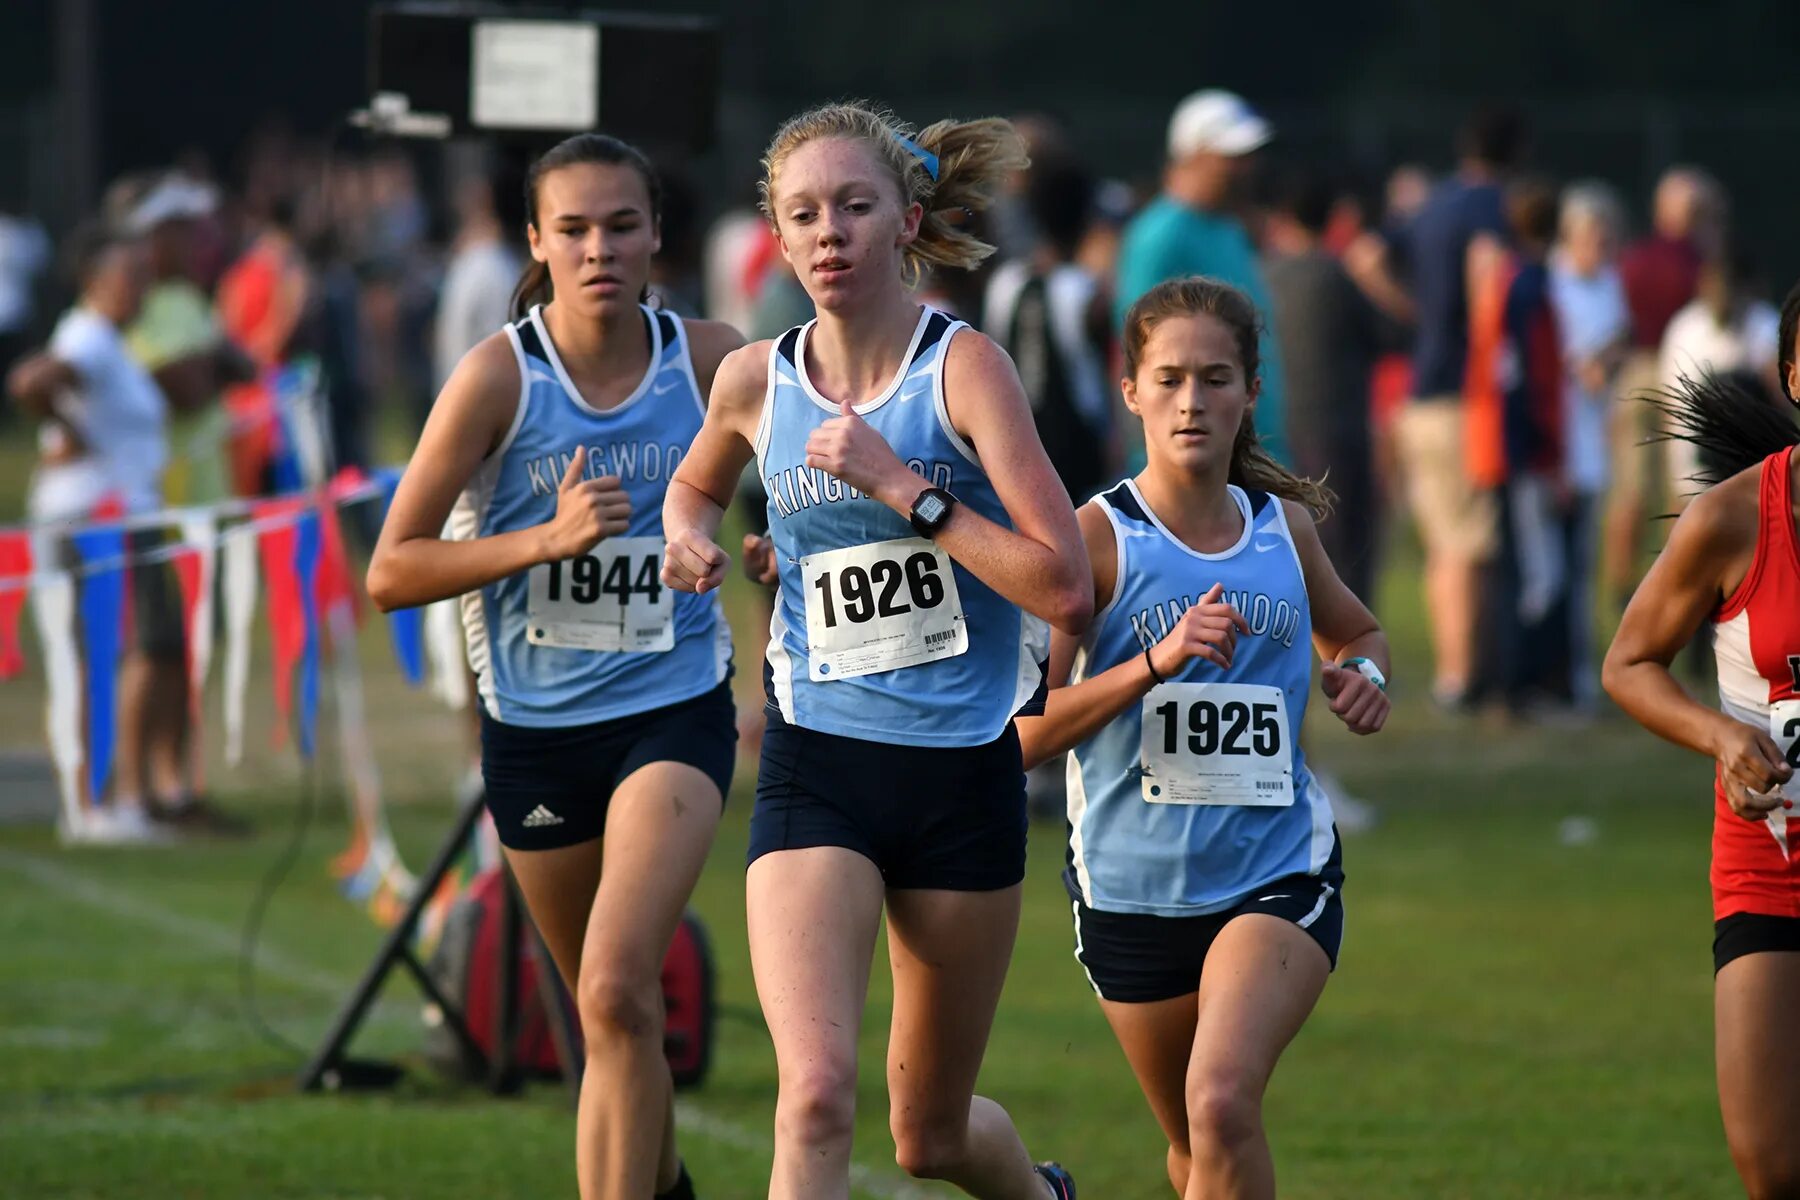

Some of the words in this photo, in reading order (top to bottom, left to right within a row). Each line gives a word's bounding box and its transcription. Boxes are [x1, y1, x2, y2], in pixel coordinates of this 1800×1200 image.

[527, 441, 683, 496] KIGWOO
[767, 457, 954, 520] KINGD
[549, 554, 662, 605] 1944
[815, 552, 944, 628] 1926
[1130, 590, 1300, 650] KINWOOD
[1156, 701, 1280, 757] 1925
